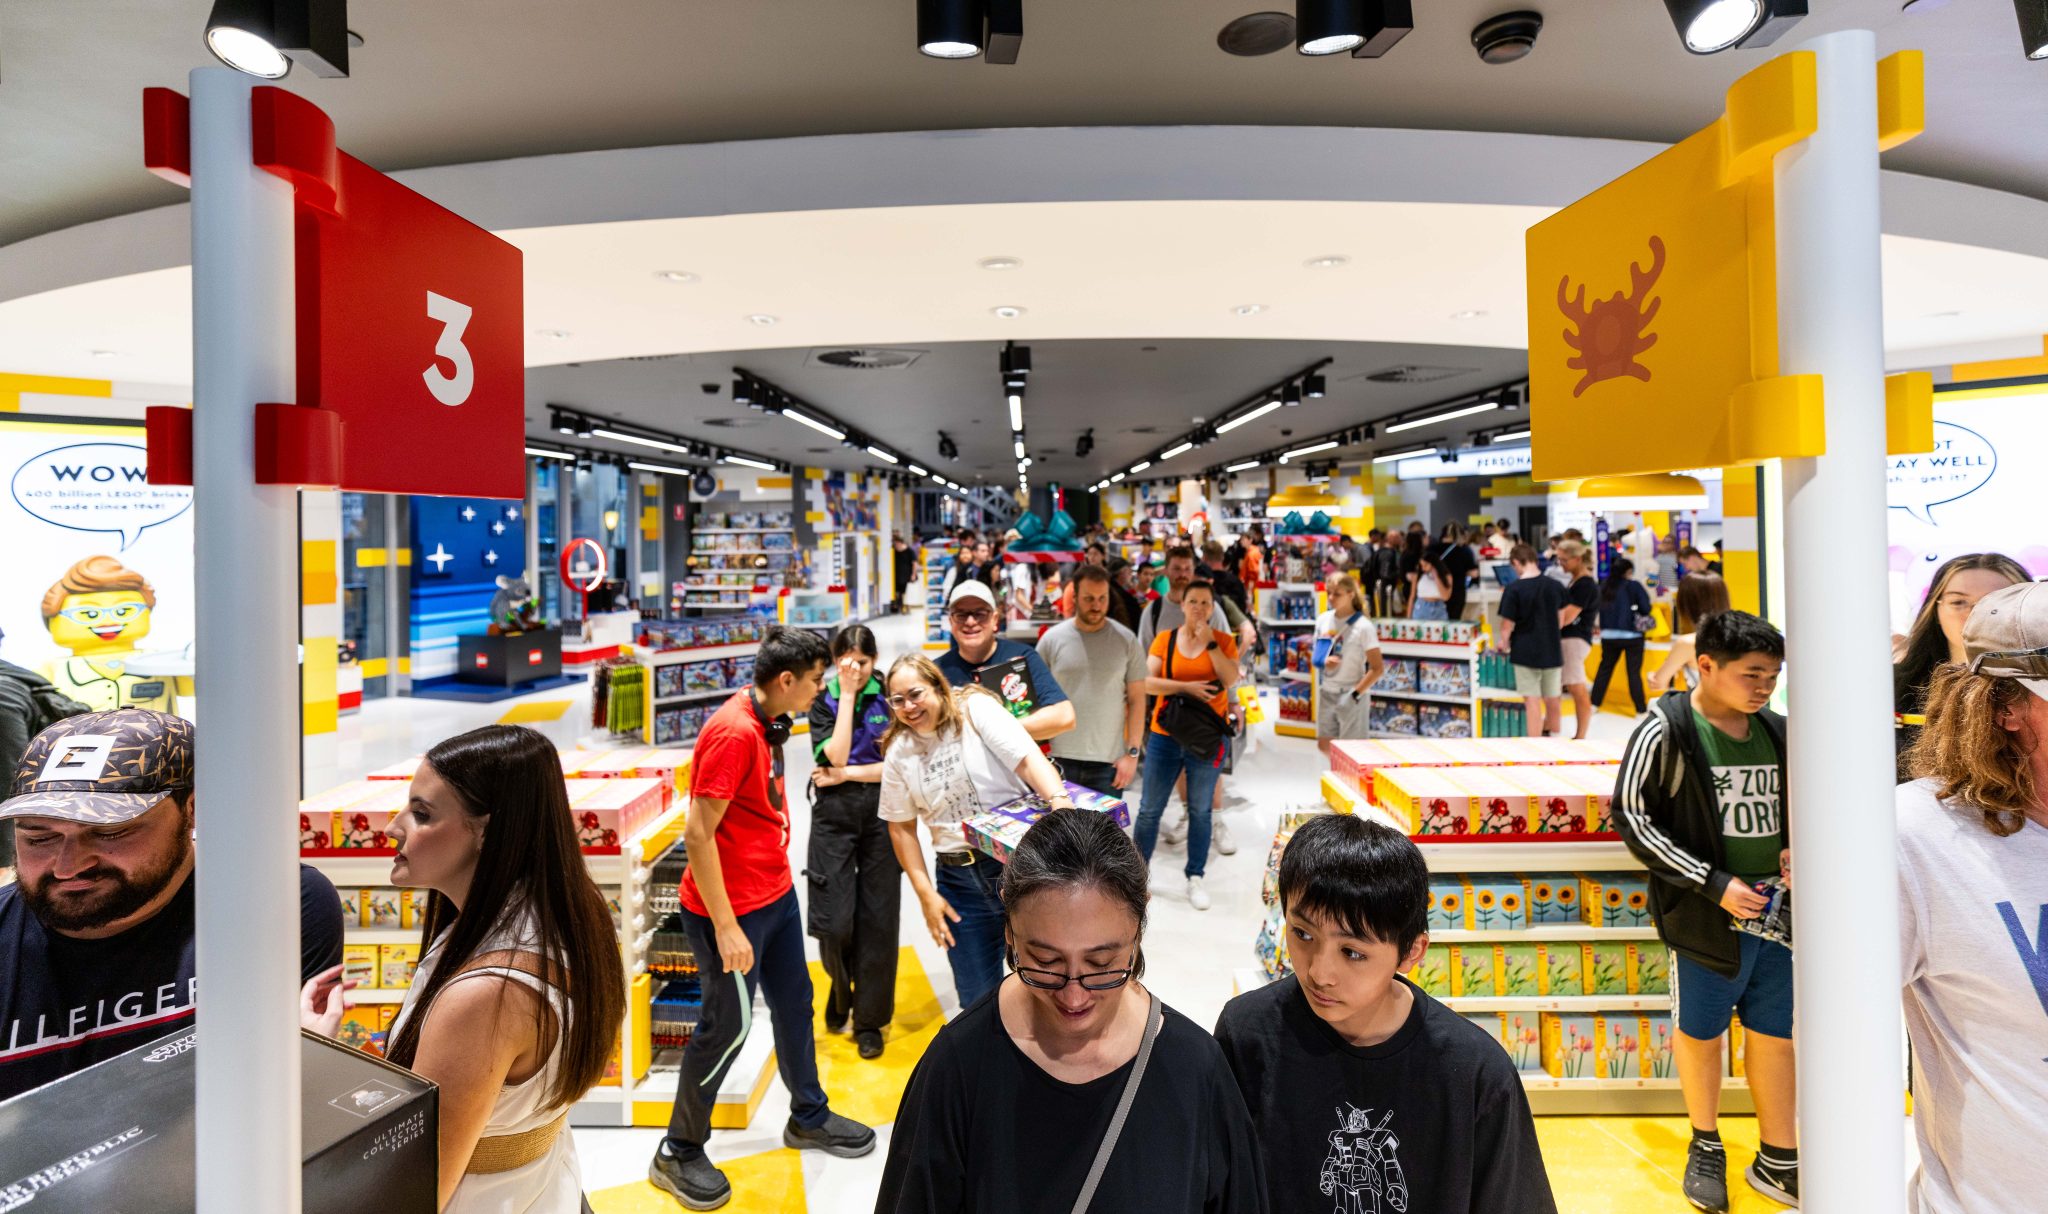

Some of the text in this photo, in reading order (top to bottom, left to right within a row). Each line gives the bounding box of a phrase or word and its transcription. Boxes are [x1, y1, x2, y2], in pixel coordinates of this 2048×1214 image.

[422, 289, 475, 407] 3
[1929, 456, 1987, 466] WELL
[58, 489, 102, 498] billion
[151, 490, 190, 498] bricks
[363, 1120, 424, 1160] COLLECTOR
[374, 1110, 424, 1144] ULTIMATE
[391, 1127, 425, 1152] SERIES
